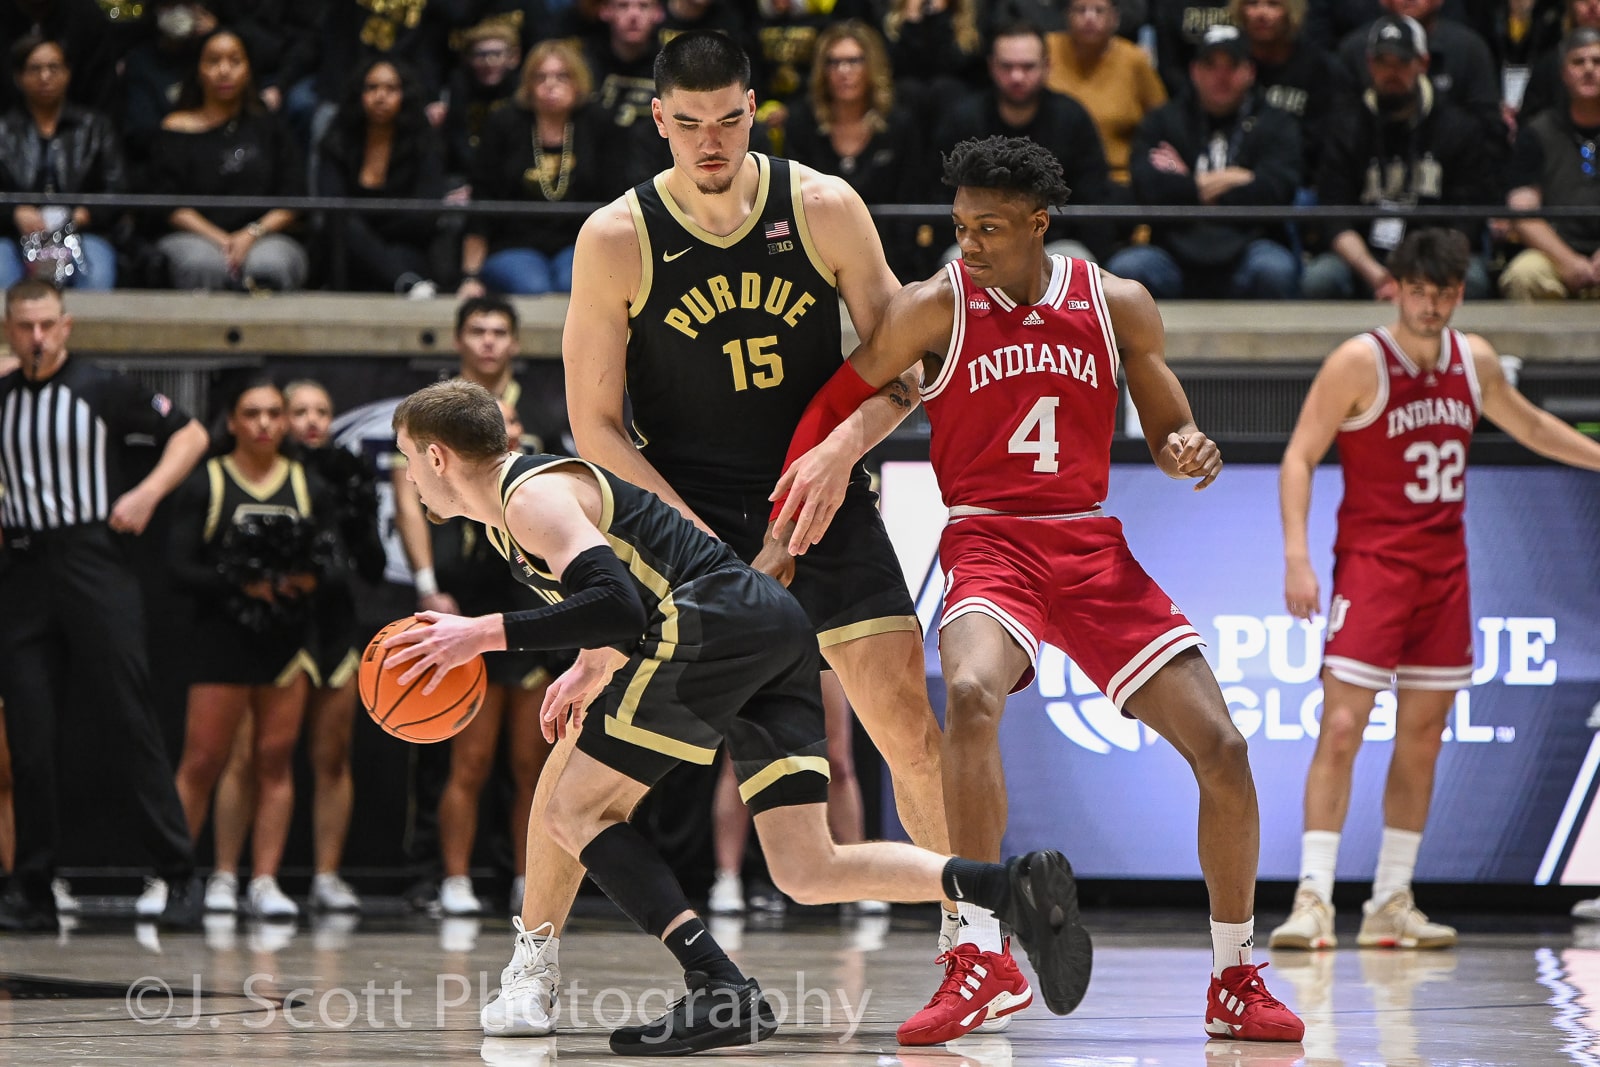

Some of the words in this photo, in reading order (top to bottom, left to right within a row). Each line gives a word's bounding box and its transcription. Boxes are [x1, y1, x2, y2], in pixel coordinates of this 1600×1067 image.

[664, 272, 816, 339] PURDUE
[1022, 318, 1045, 326] adidas
[722, 335, 785, 392] 15
[967, 343, 1099, 394] INDIANA
[1008, 396, 1060, 474] 4
[1404, 440, 1466, 504] 32
